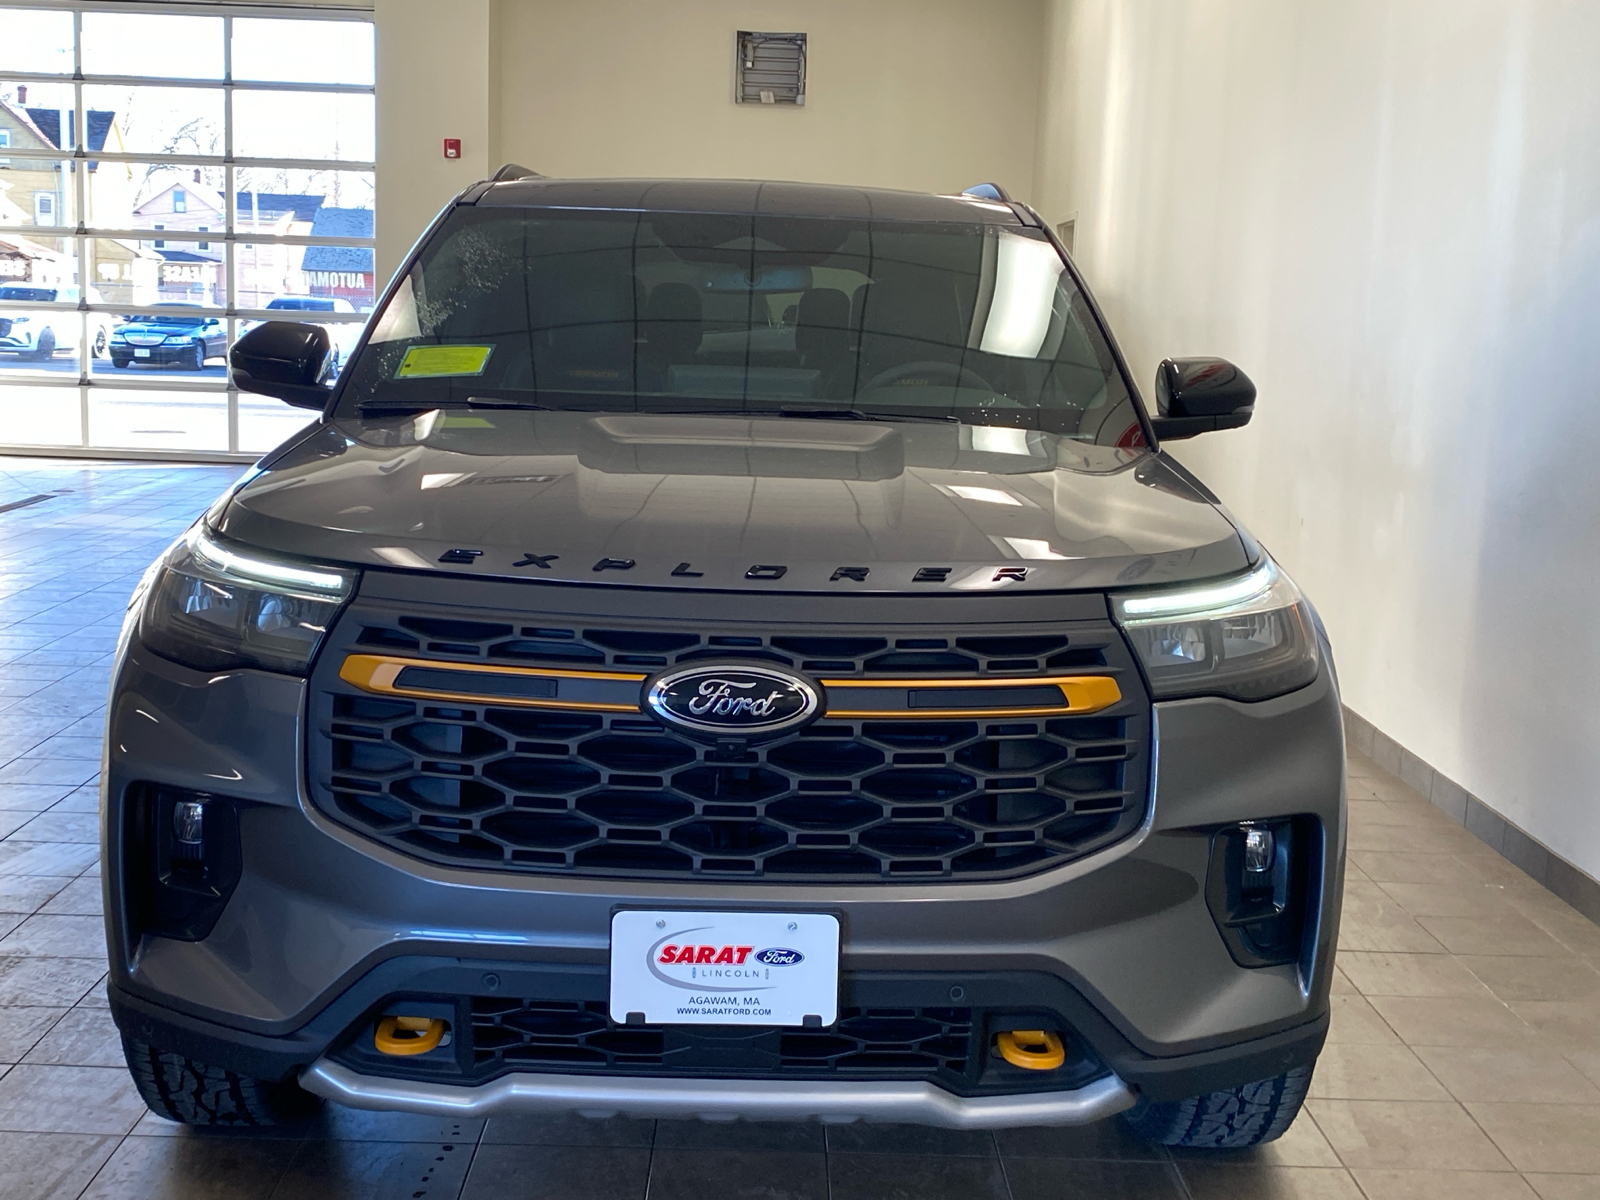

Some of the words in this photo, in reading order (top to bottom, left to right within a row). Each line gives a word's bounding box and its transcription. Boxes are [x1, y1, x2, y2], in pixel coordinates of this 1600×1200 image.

[438, 549, 1029, 582] EXPLORER
[688, 678, 784, 717] Ford
[656, 943, 755, 966] SARAT
[763, 949, 795, 965] Ford
[701, 969, 760, 978] LINCOLN
[688, 996, 740, 1007] AGAWAM,
[743, 996, 761, 1006] MA
[676, 1007, 772, 1016] WWW.SARATFORD.COM
